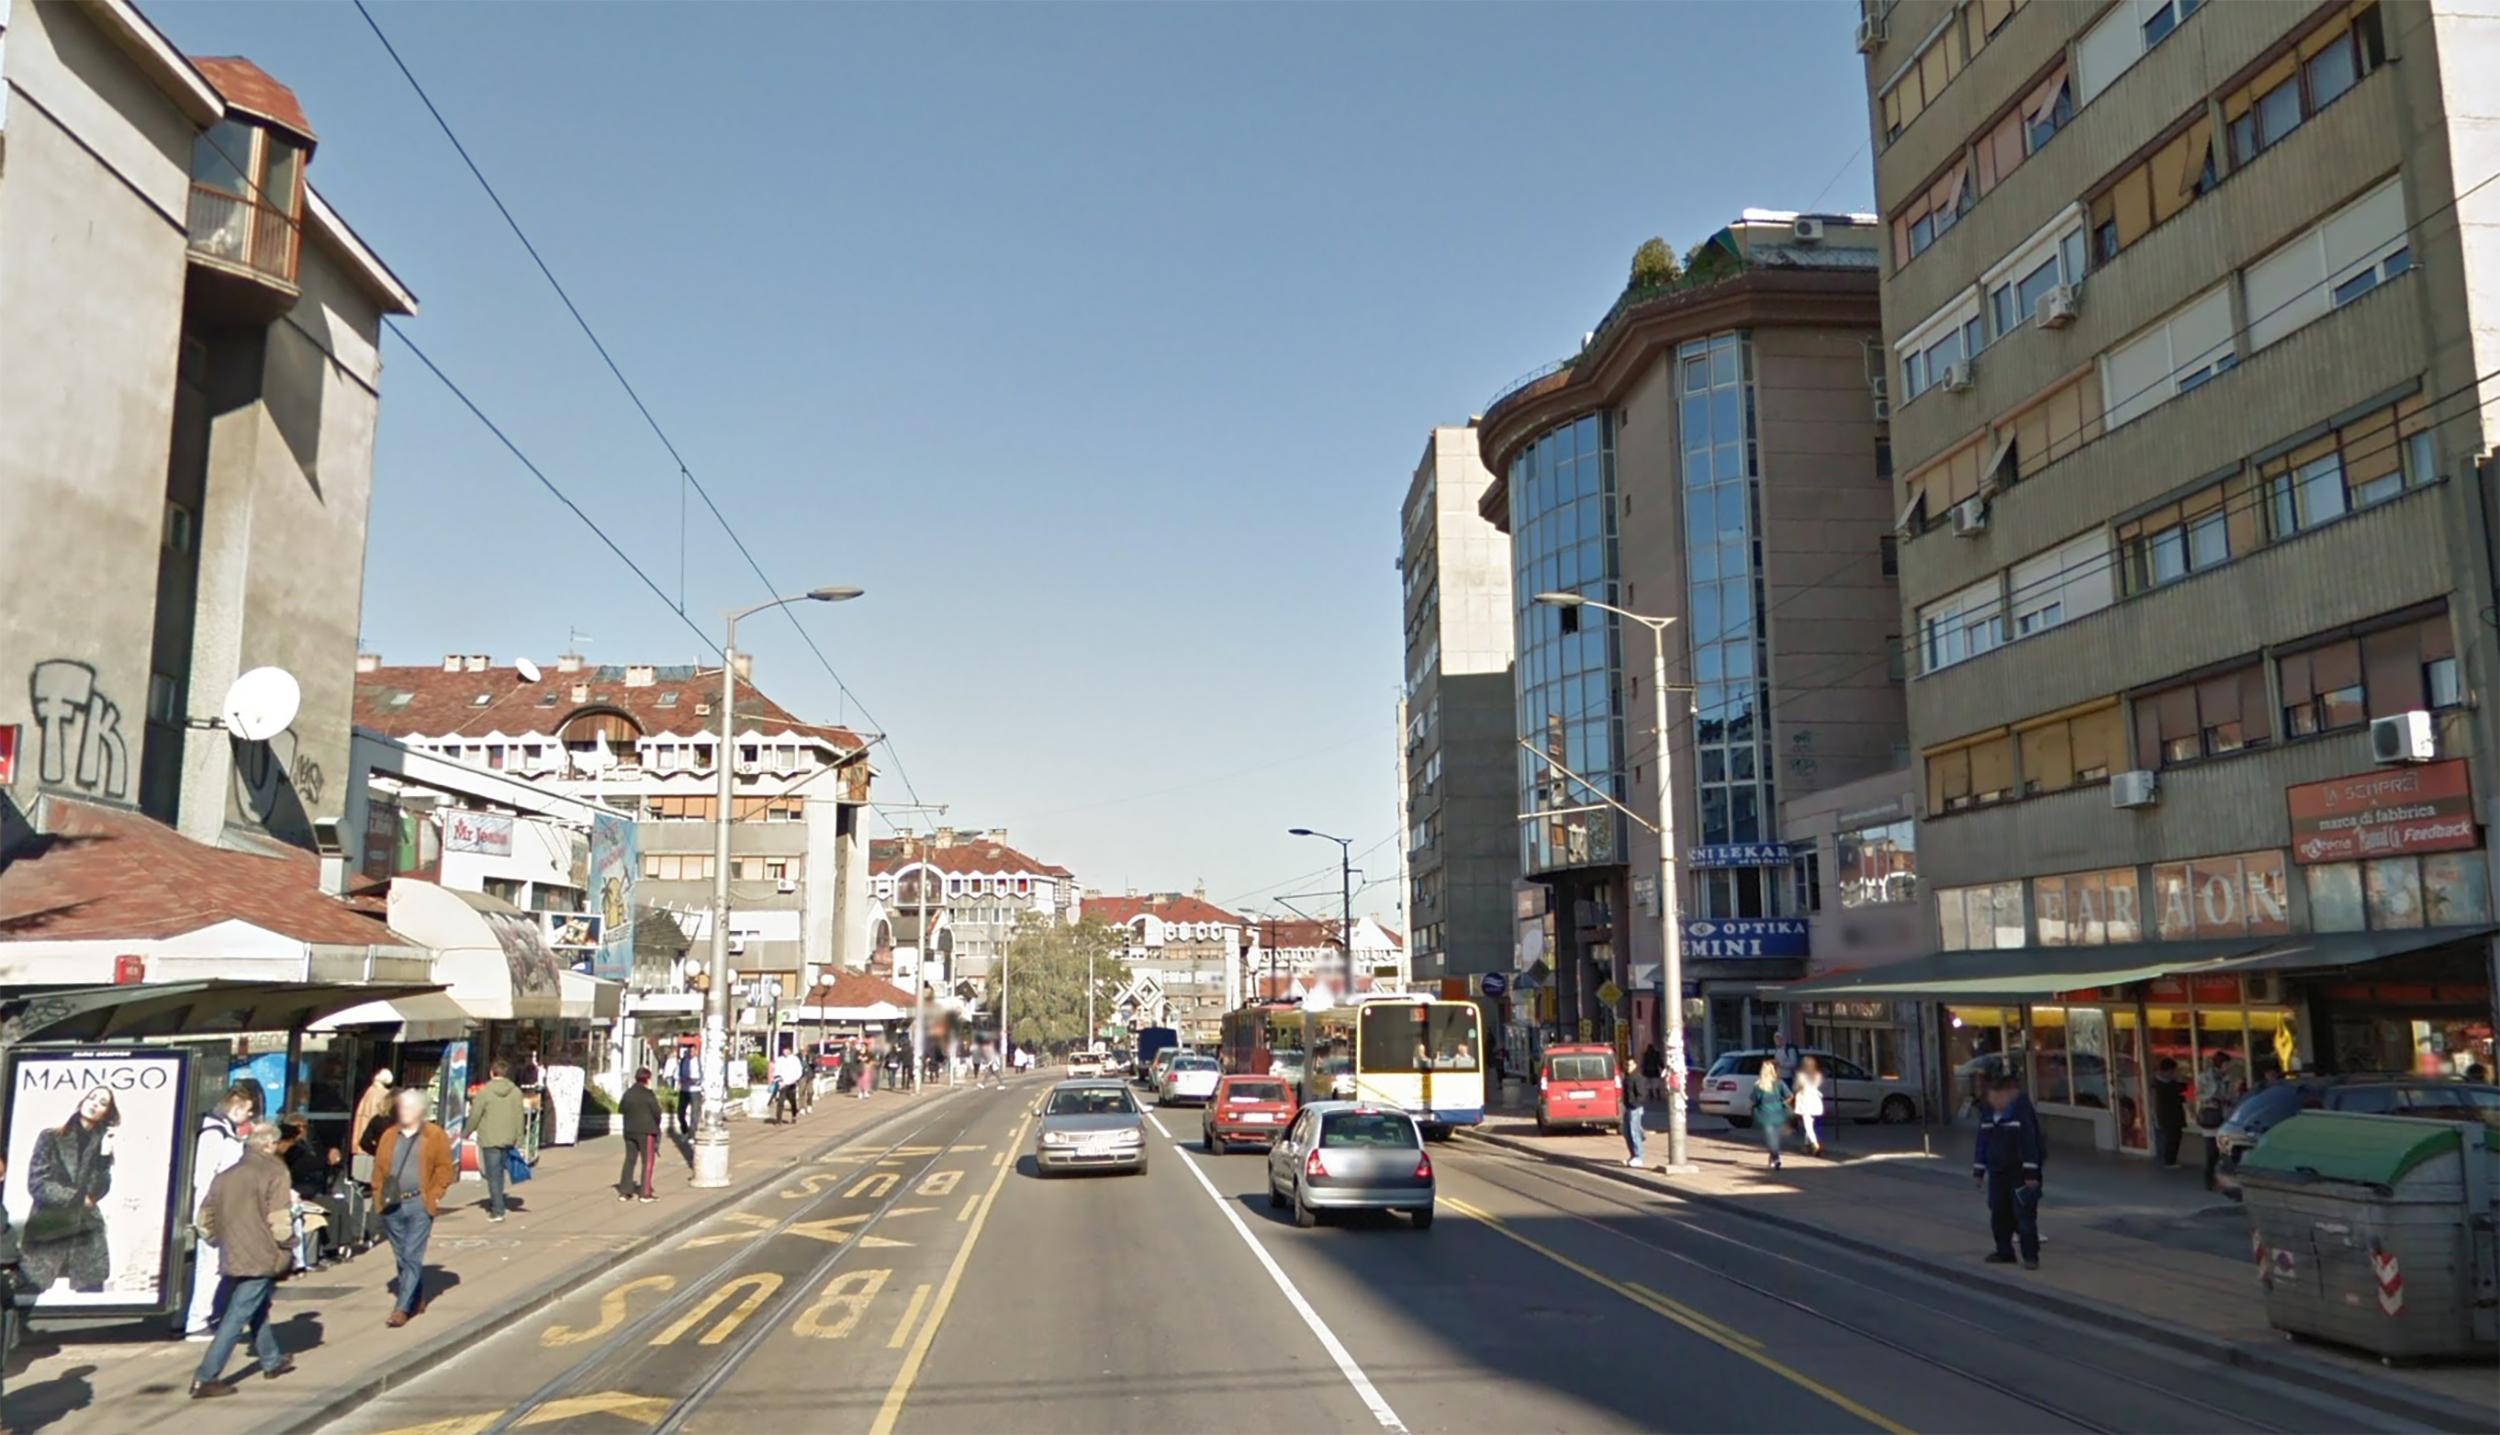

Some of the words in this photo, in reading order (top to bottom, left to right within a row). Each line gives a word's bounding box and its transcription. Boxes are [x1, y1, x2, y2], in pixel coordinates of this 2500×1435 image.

[2319, 816, 2358, 831] marca
[2359, 812, 2374, 826] di
[2375, 804, 2437, 823] fabbrica
[453, 819, 473, 841] Mr
[2403, 821, 2472, 843] Feedback
[1719, 846, 1790, 859] LEKAR
[2041, 868, 2286, 936] FARAON
[1723, 921, 1806, 935] OPTIKA
[1680, 939, 1762, 957] EMINI
[22, 1066, 168, 1091] MANGO
[781, 1170, 964, 1200] BUS
[538, 1268, 893, 1348] BUS
